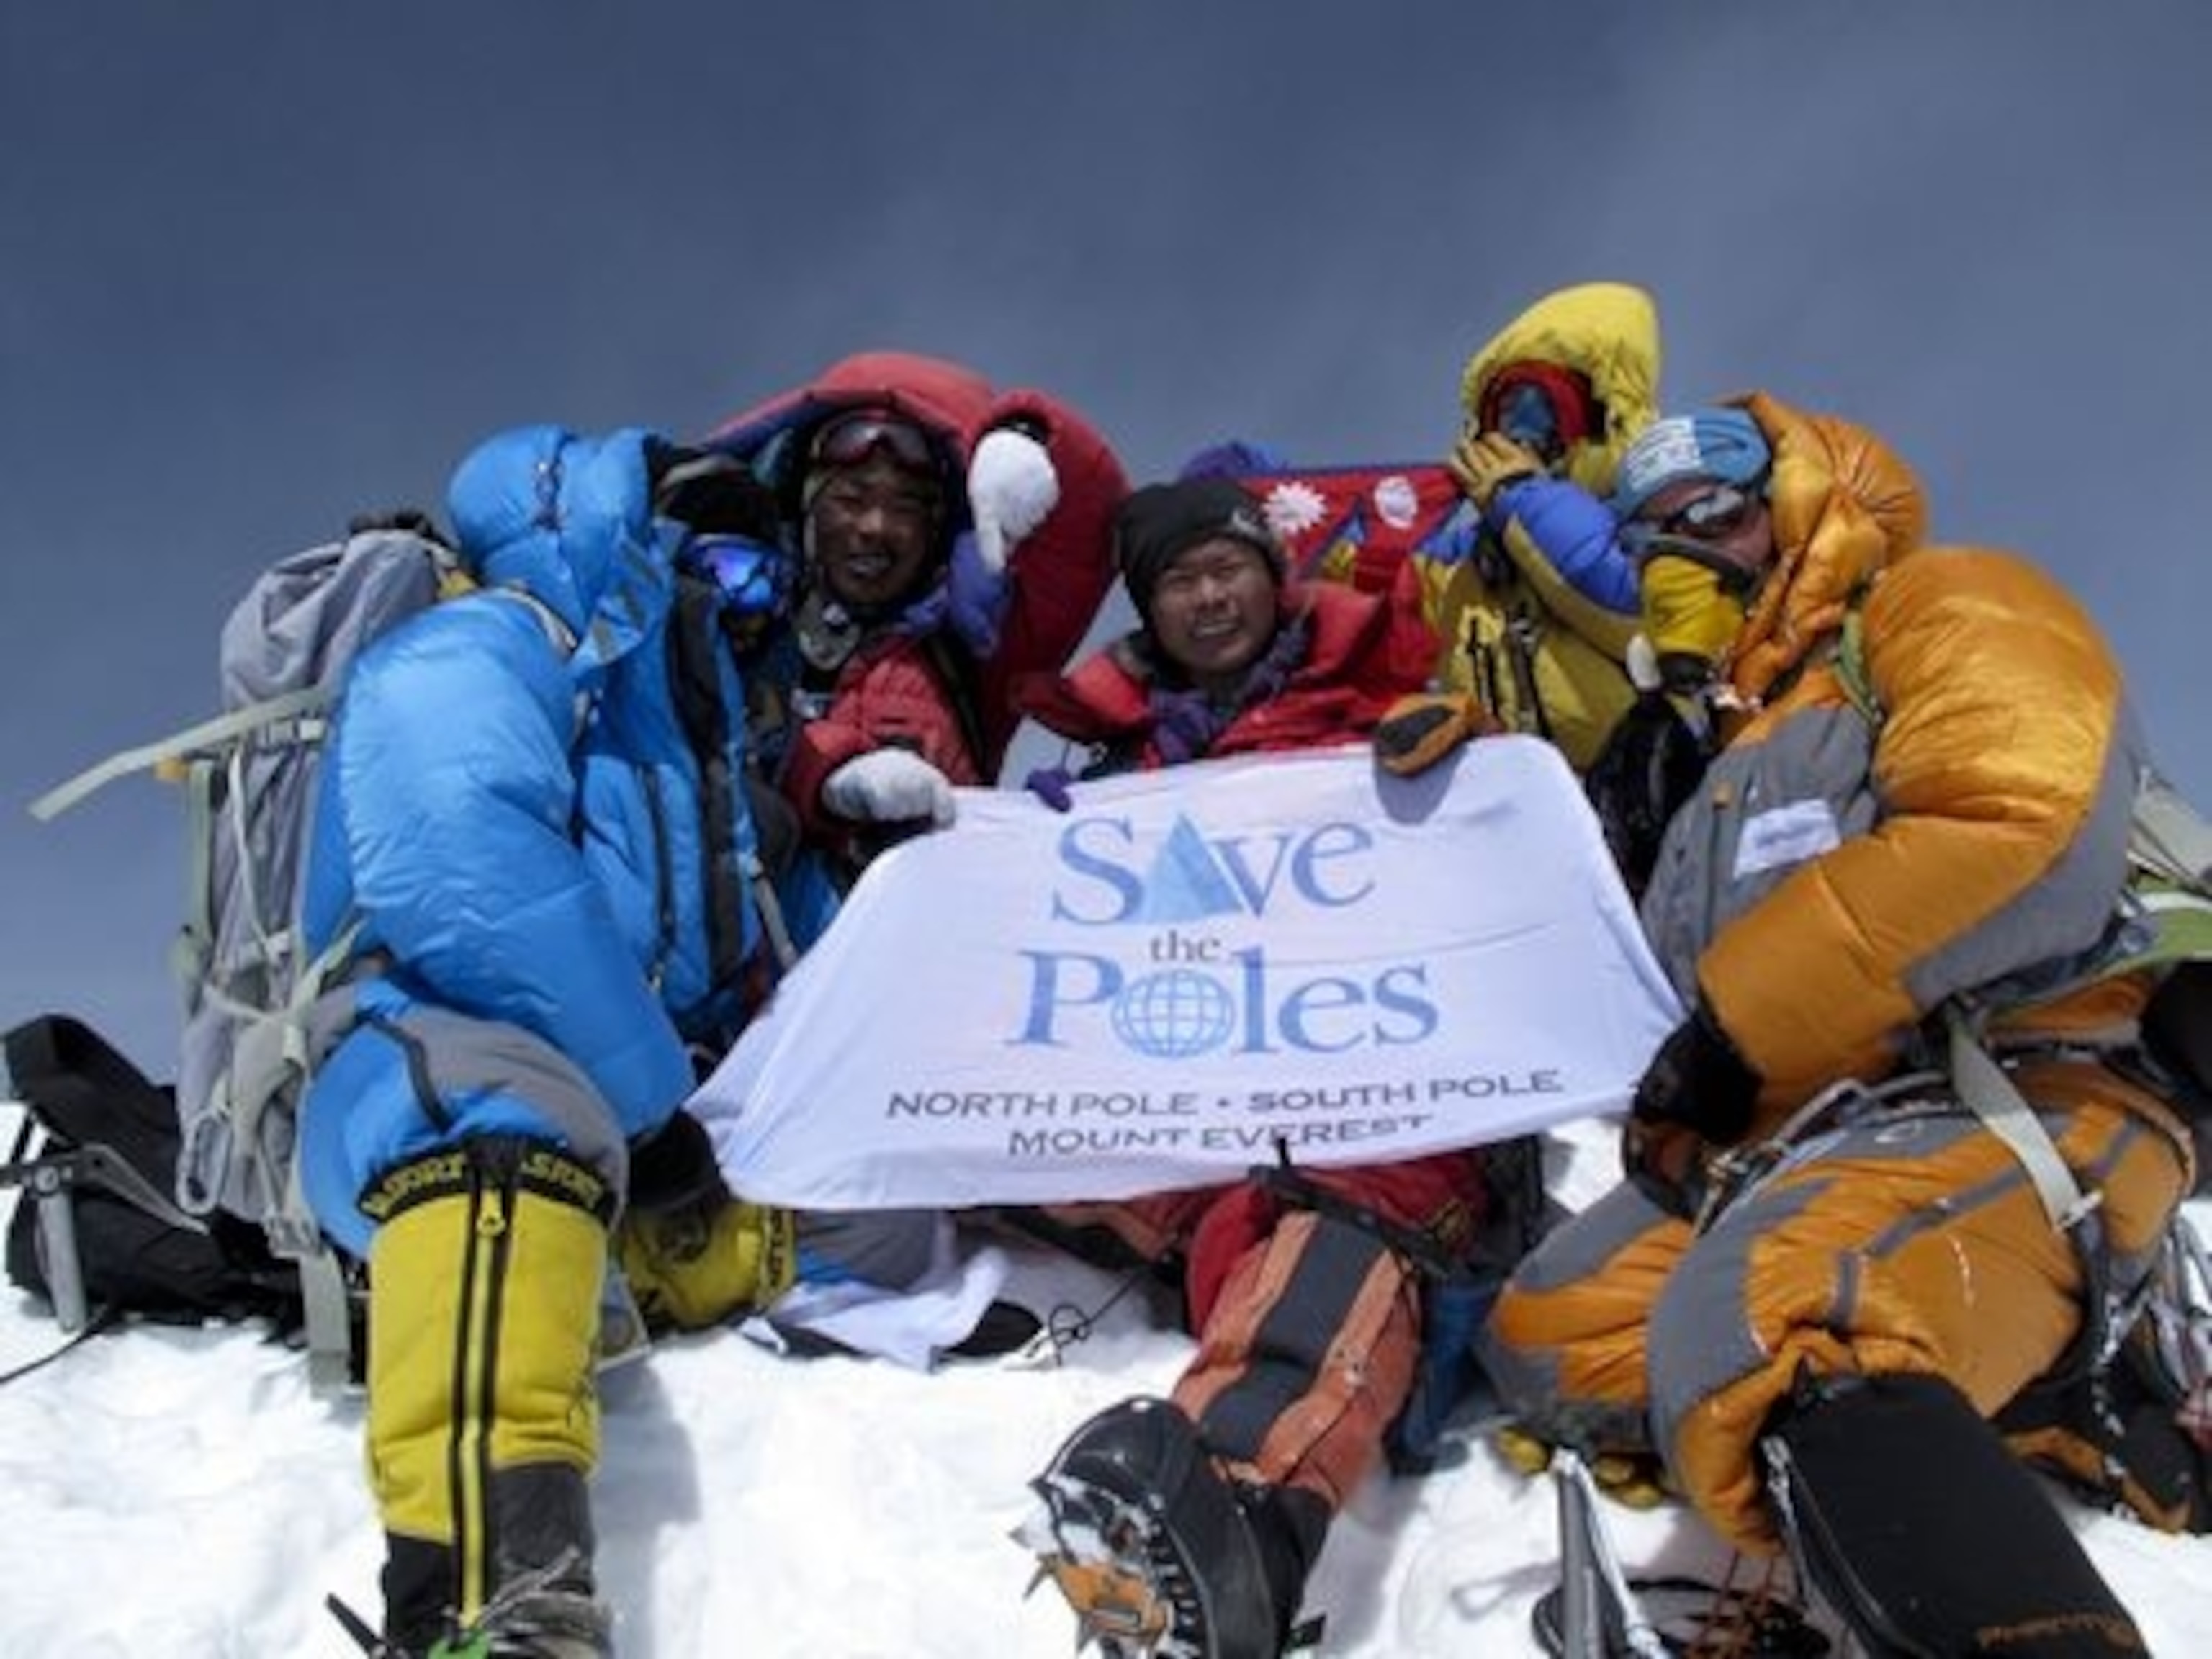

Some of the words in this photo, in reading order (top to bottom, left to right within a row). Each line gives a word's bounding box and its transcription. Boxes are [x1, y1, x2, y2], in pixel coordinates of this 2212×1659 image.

[1150, 930, 1222, 963] the
[886, 1091, 1058, 1119] NORTH
[1069, 1091, 1200, 1118] POLE
[1247, 1083, 1416, 1112] SOUTH
[1428, 1069, 1565, 1101] POLE
[1008, 1127, 1192, 1156] MOUNT
[1201, 1112, 1436, 1151] EVEREST
